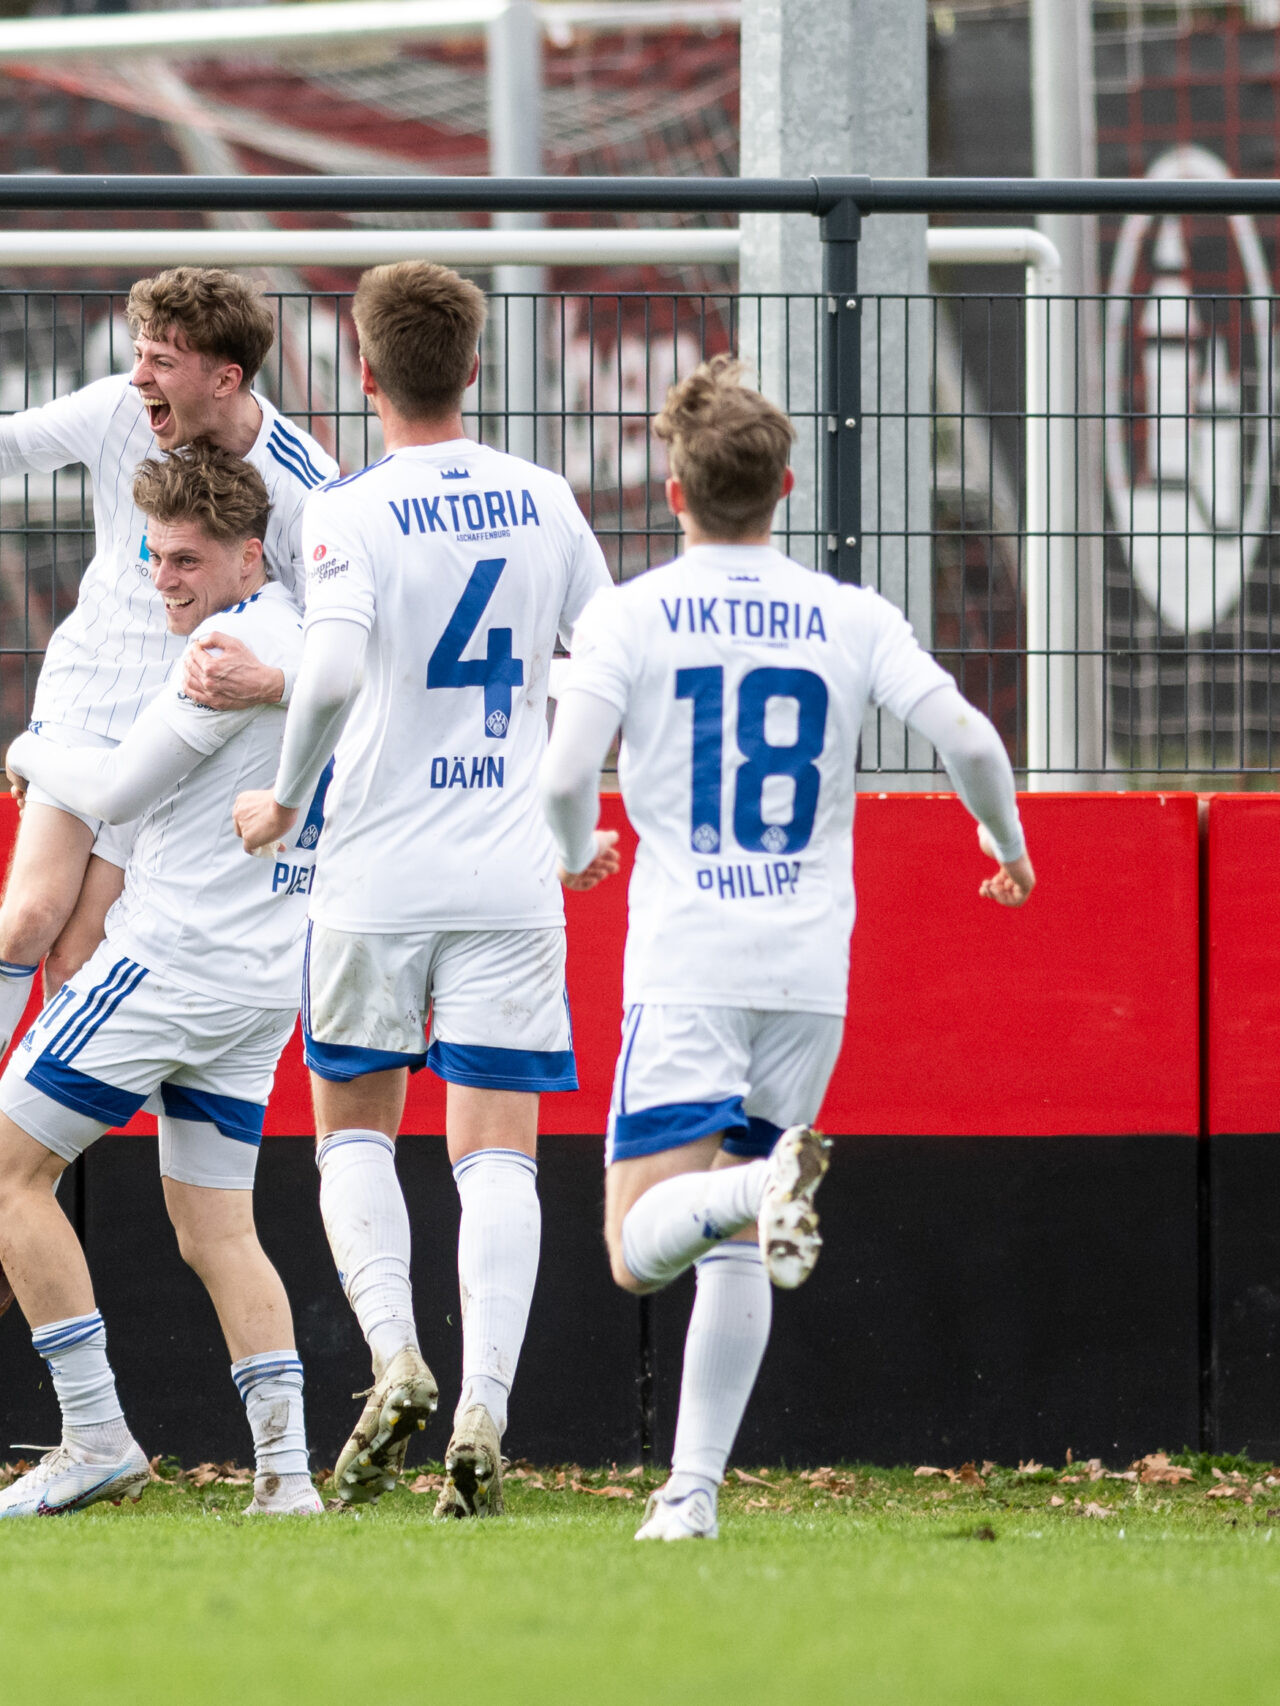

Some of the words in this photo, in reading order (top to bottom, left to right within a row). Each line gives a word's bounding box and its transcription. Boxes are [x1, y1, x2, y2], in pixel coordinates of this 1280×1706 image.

[388, 489, 540, 536] VIKTORIA
[661, 597, 827, 642] VIKTORIA
[426, 557, 524, 739] 4
[430, 756, 504, 789] DÄHN
[675, 665, 829, 855] 18
[38, 984, 77, 1029] 11
